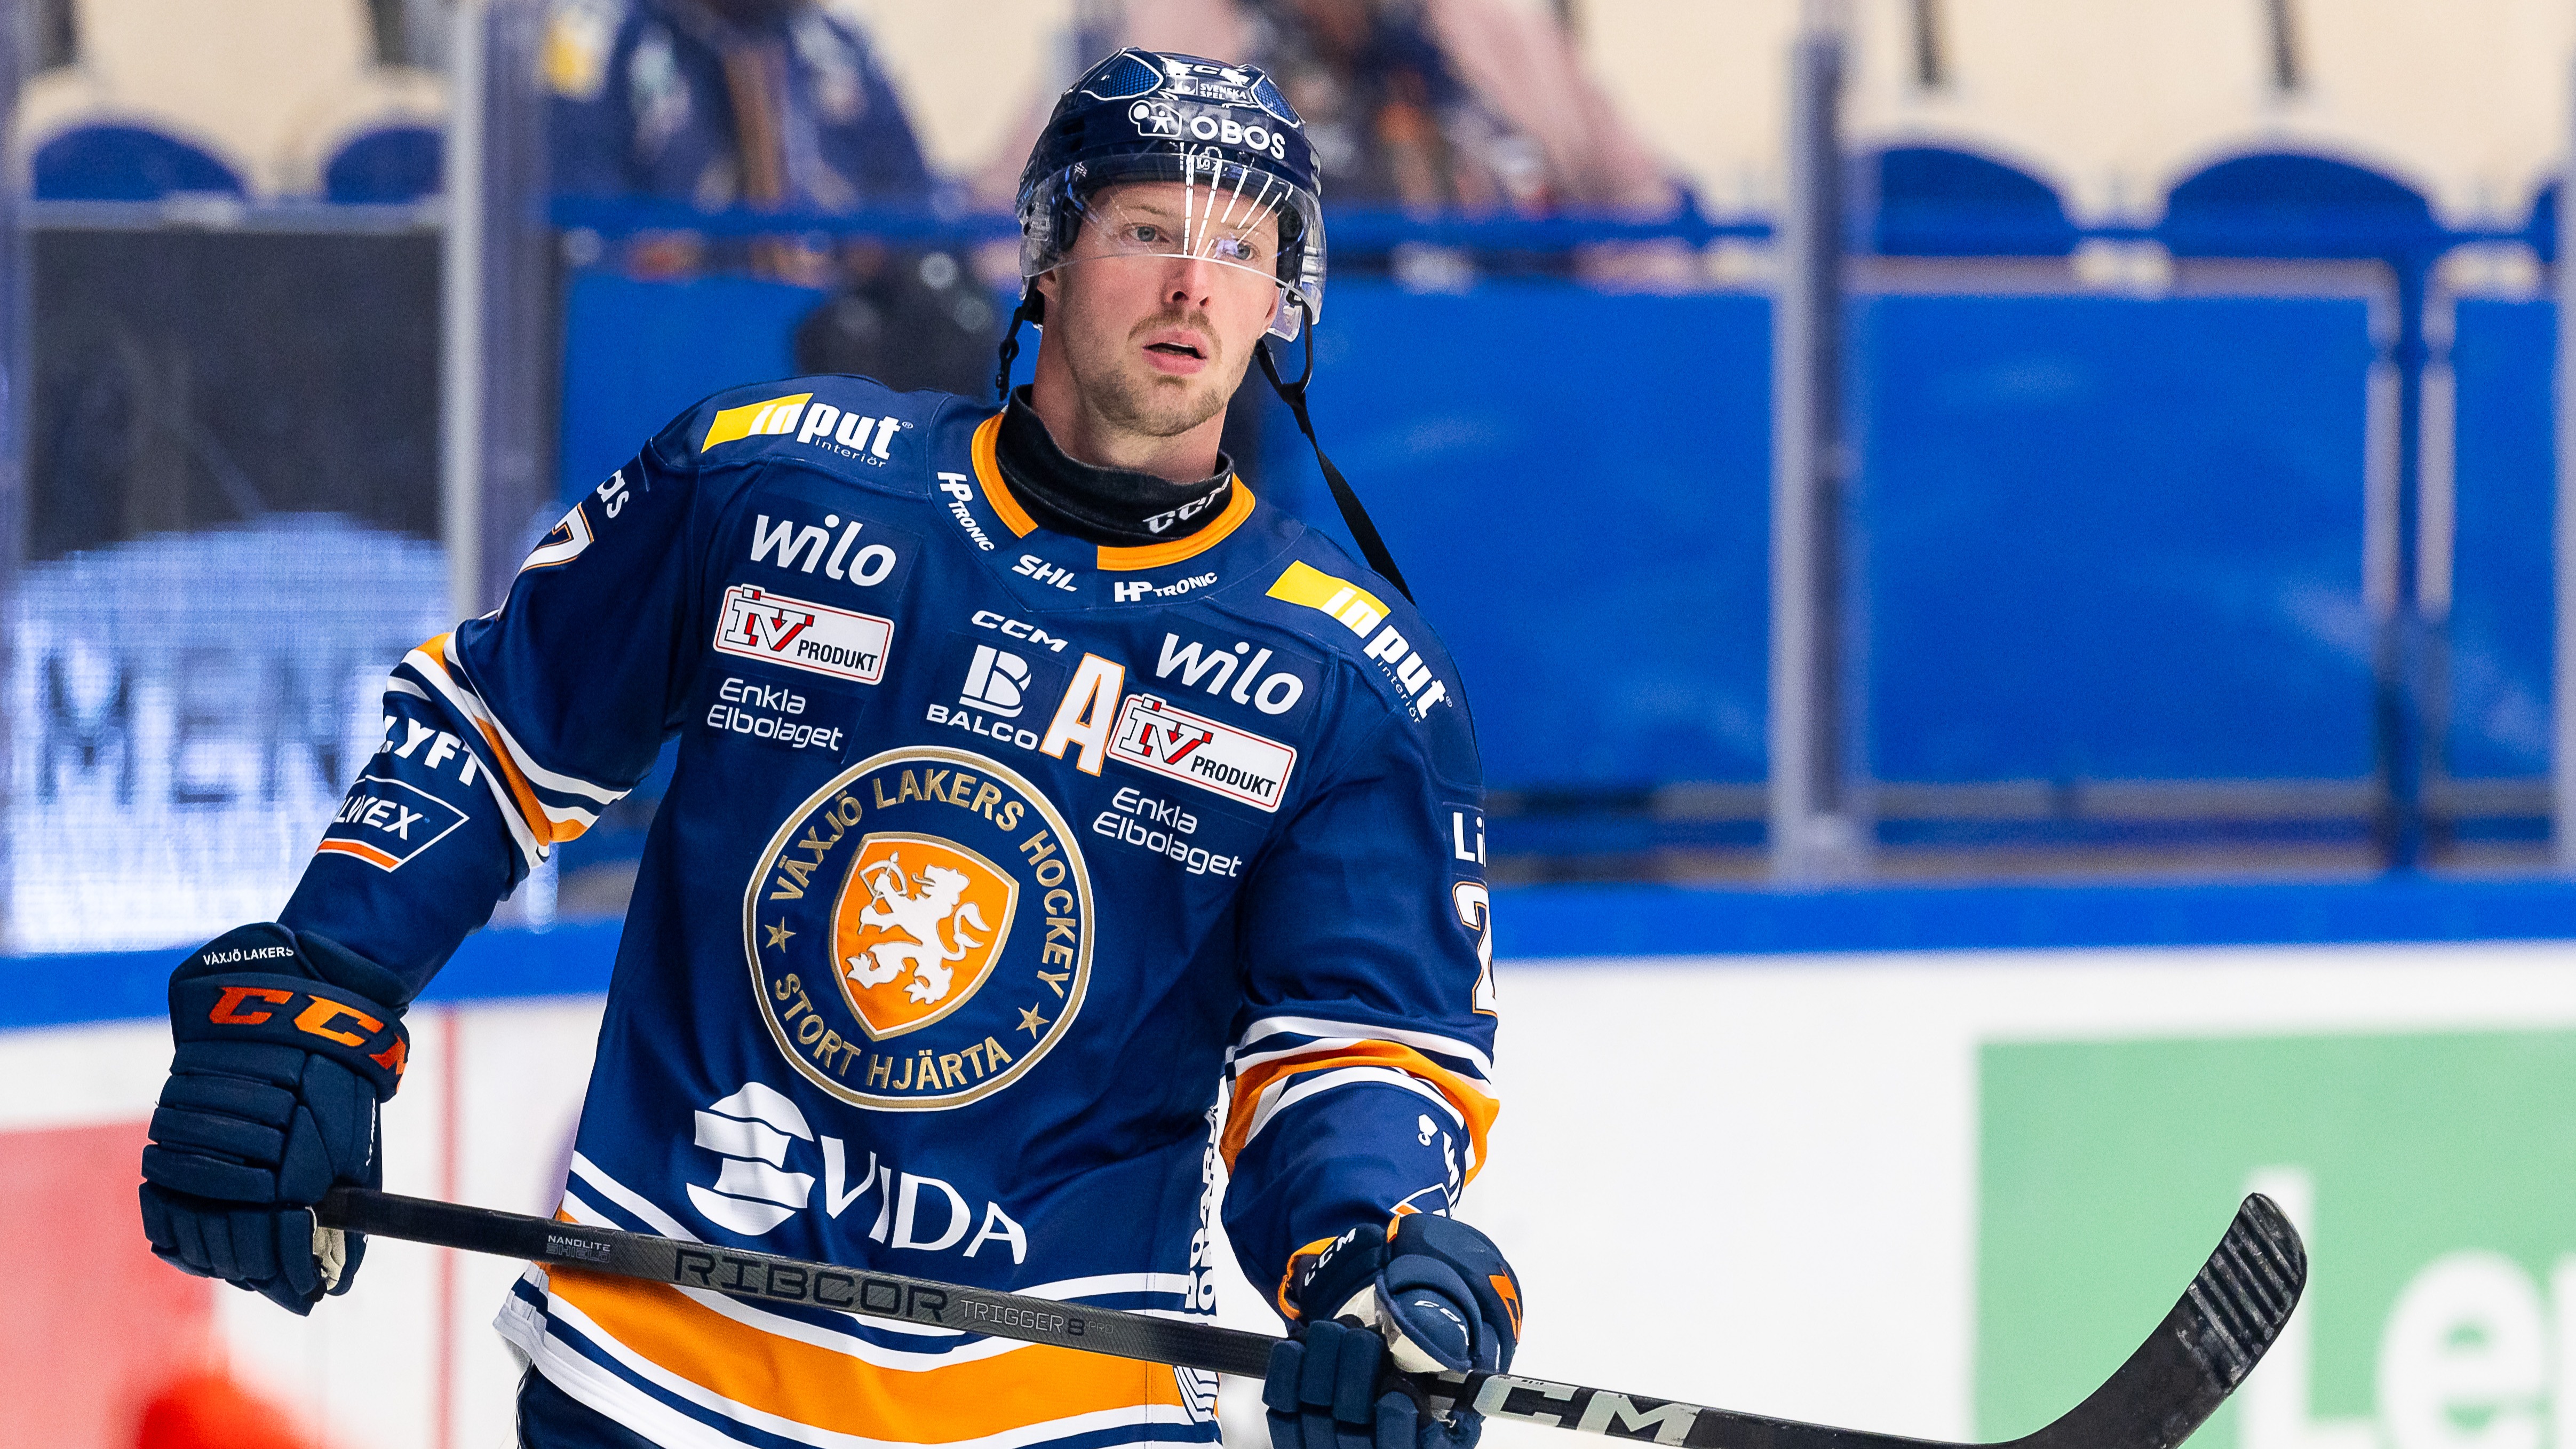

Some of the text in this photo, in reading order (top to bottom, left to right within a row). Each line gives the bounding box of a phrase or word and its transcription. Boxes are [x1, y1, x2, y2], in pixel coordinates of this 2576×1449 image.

[1200, 83, 1247, 99] SVENSKA
[1200, 91, 1224, 99] SPEL
[1190, 115, 1285, 160] OBOS
[747, 401, 901, 460] input
[815, 437, 886, 468] interiör
[750, 514, 897, 587] wilo
[1012, 555, 1077, 592] SHL
[797, 640, 878, 672] PRODUKT
[971, 610, 1068, 653] CCM
[1320, 587, 1446, 719] input
[719, 677, 806, 715] Enkla
[1156, 633, 1303, 715] wilo
[1378, 660, 1420, 723] interiör
[707, 704, 844, 751] Elbolaget
[926, 703, 1039, 750] BALCO
[1039, 652, 1126, 777] A
[1190, 754, 1277, 798] PRODUKT
[1111, 786, 1198, 835] Enkla
[1093, 811, 1242, 878] Elbolaget
[769, 769, 1076, 999] VÄXJÖ LAKERS HOCKEY
[203, 946, 294, 965] VÄXJÖ LAKERS
[1452, 881, 1498, 1018] 2
[775, 973, 1013, 1090] STORT HJÄRTA
[820, 1135, 1028, 1265] VIDA
[546, 1242, 610, 1263] SHIELD
[548, 1235, 611, 1252] NANOLITE
[1305, 1228, 1356, 1287] CCM
[674, 1248, 948, 1323] RIBCOR
[960, 1300, 1064, 1333] TRIGGER
[1088, 1321, 1114, 1335] PRO
[2244, 1171, 2576, 1449] Le
